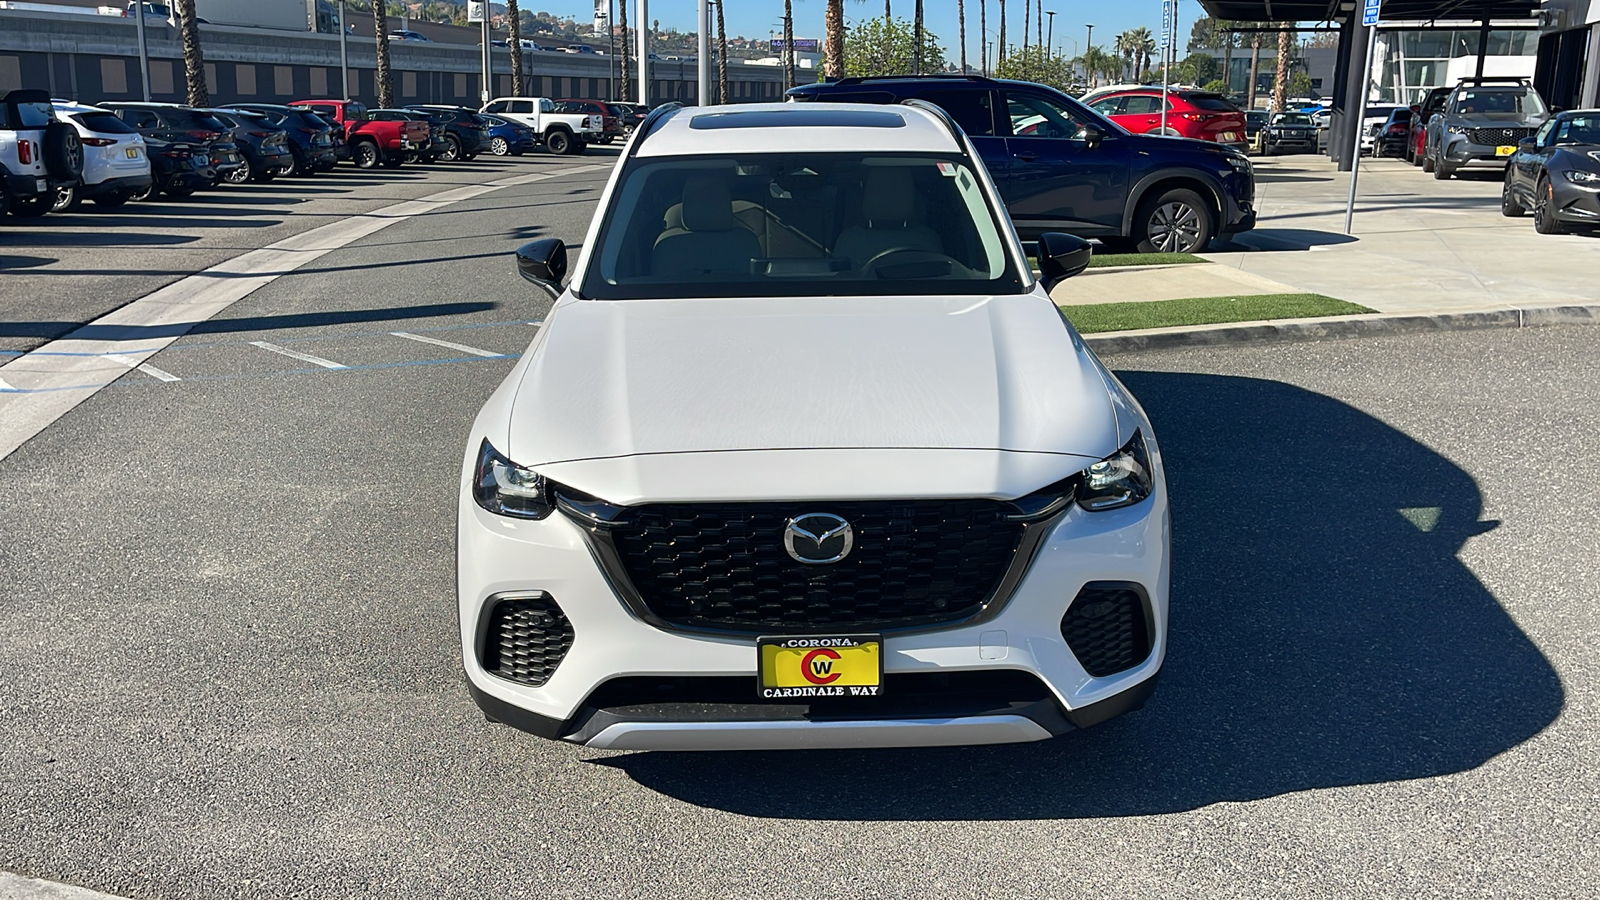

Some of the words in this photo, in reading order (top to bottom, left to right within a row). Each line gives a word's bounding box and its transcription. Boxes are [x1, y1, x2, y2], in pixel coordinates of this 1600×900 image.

[788, 638, 852, 647] CORONA
[801, 648, 842, 685] C
[812, 660, 833, 675] W
[763, 687, 844, 698] CARDINALE
[850, 686, 879, 696] WAY
